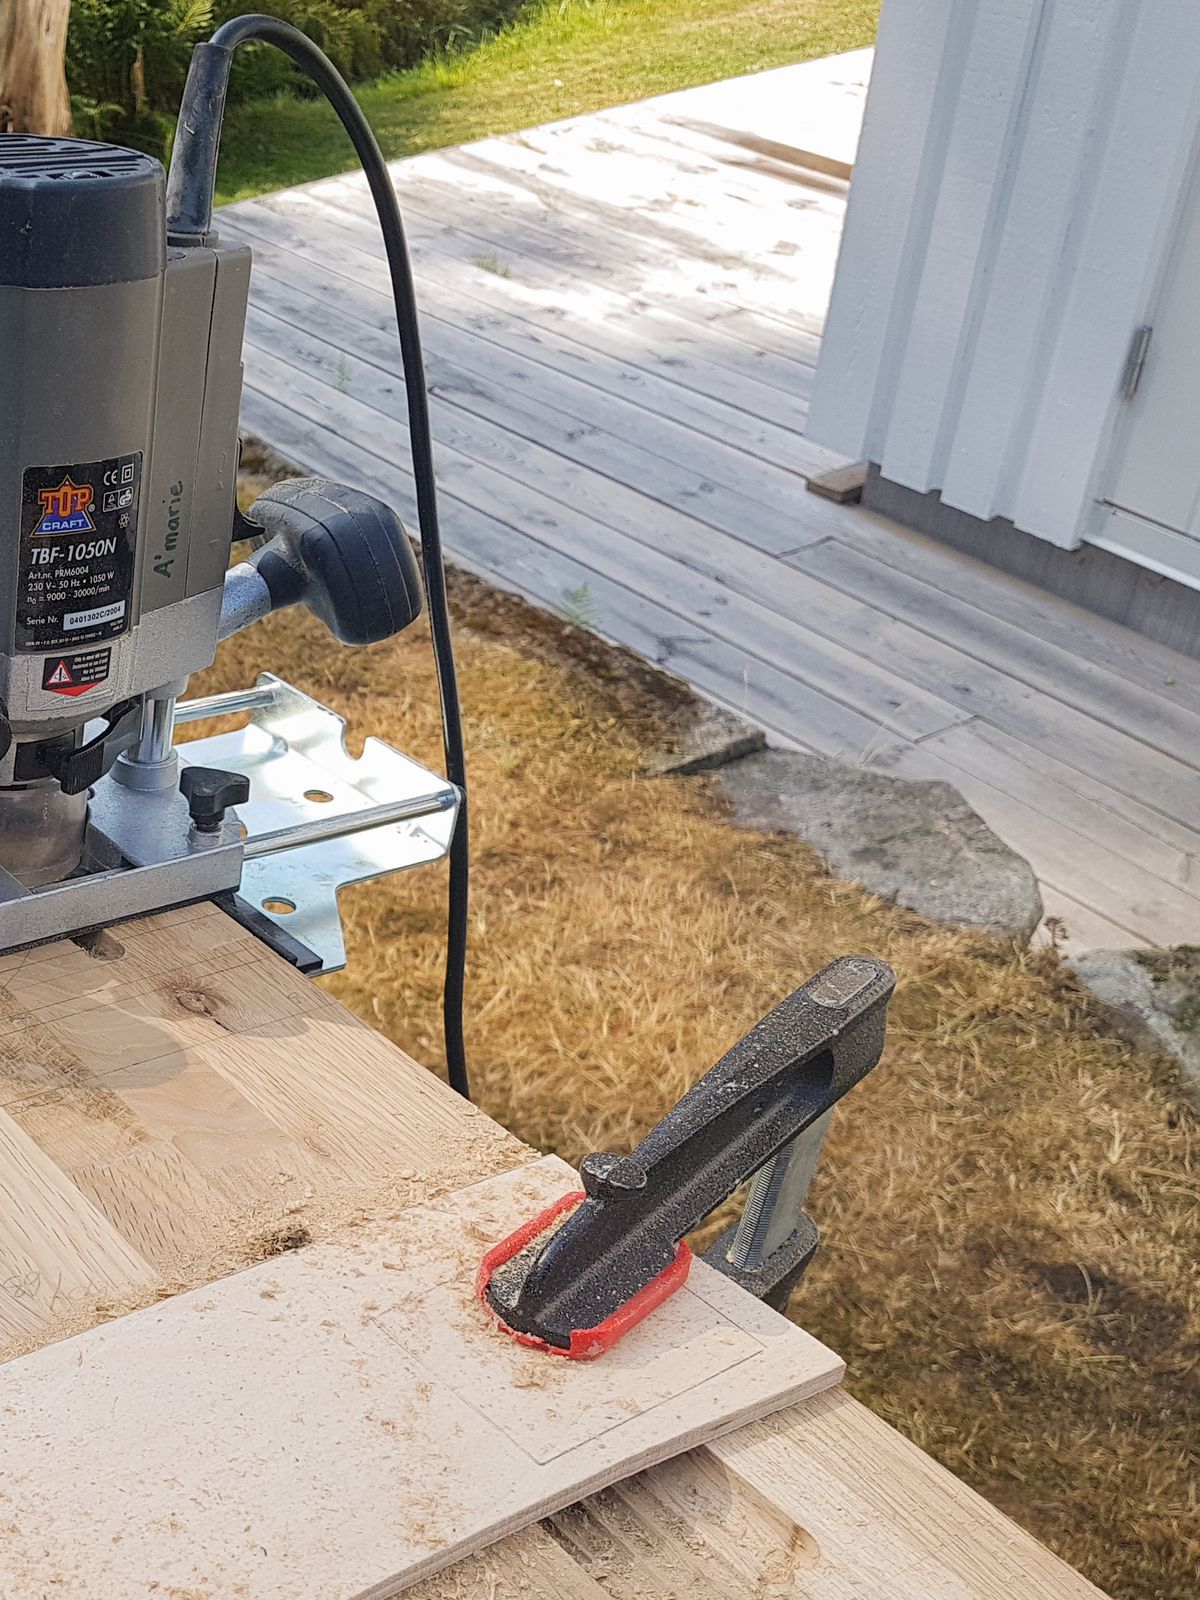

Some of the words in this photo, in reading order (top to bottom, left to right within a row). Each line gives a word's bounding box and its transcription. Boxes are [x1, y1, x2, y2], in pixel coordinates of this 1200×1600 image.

[103, 469, 118, 486] CE
[40, 485, 91, 518] TOP
[119, 489, 132, 506] GS
[42, 519, 85, 531] CRAFT
[30, 537, 117, 565] TBF-1050N
[27, 571, 53, 580] Art.nr.
[54, 565, 90, 578] PRM6004
[27, 582, 44, 592] 230
[58, 580, 69, 589] 50
[70, 578, 81, 587] Hz
[89, 573, 107, 584] 1050
[107, 570, 115, 580] W
[46, 592, 67, 602] 9000
[26, 617, 46, 626] Serie
[47, 615, 59, 624] Nr.
